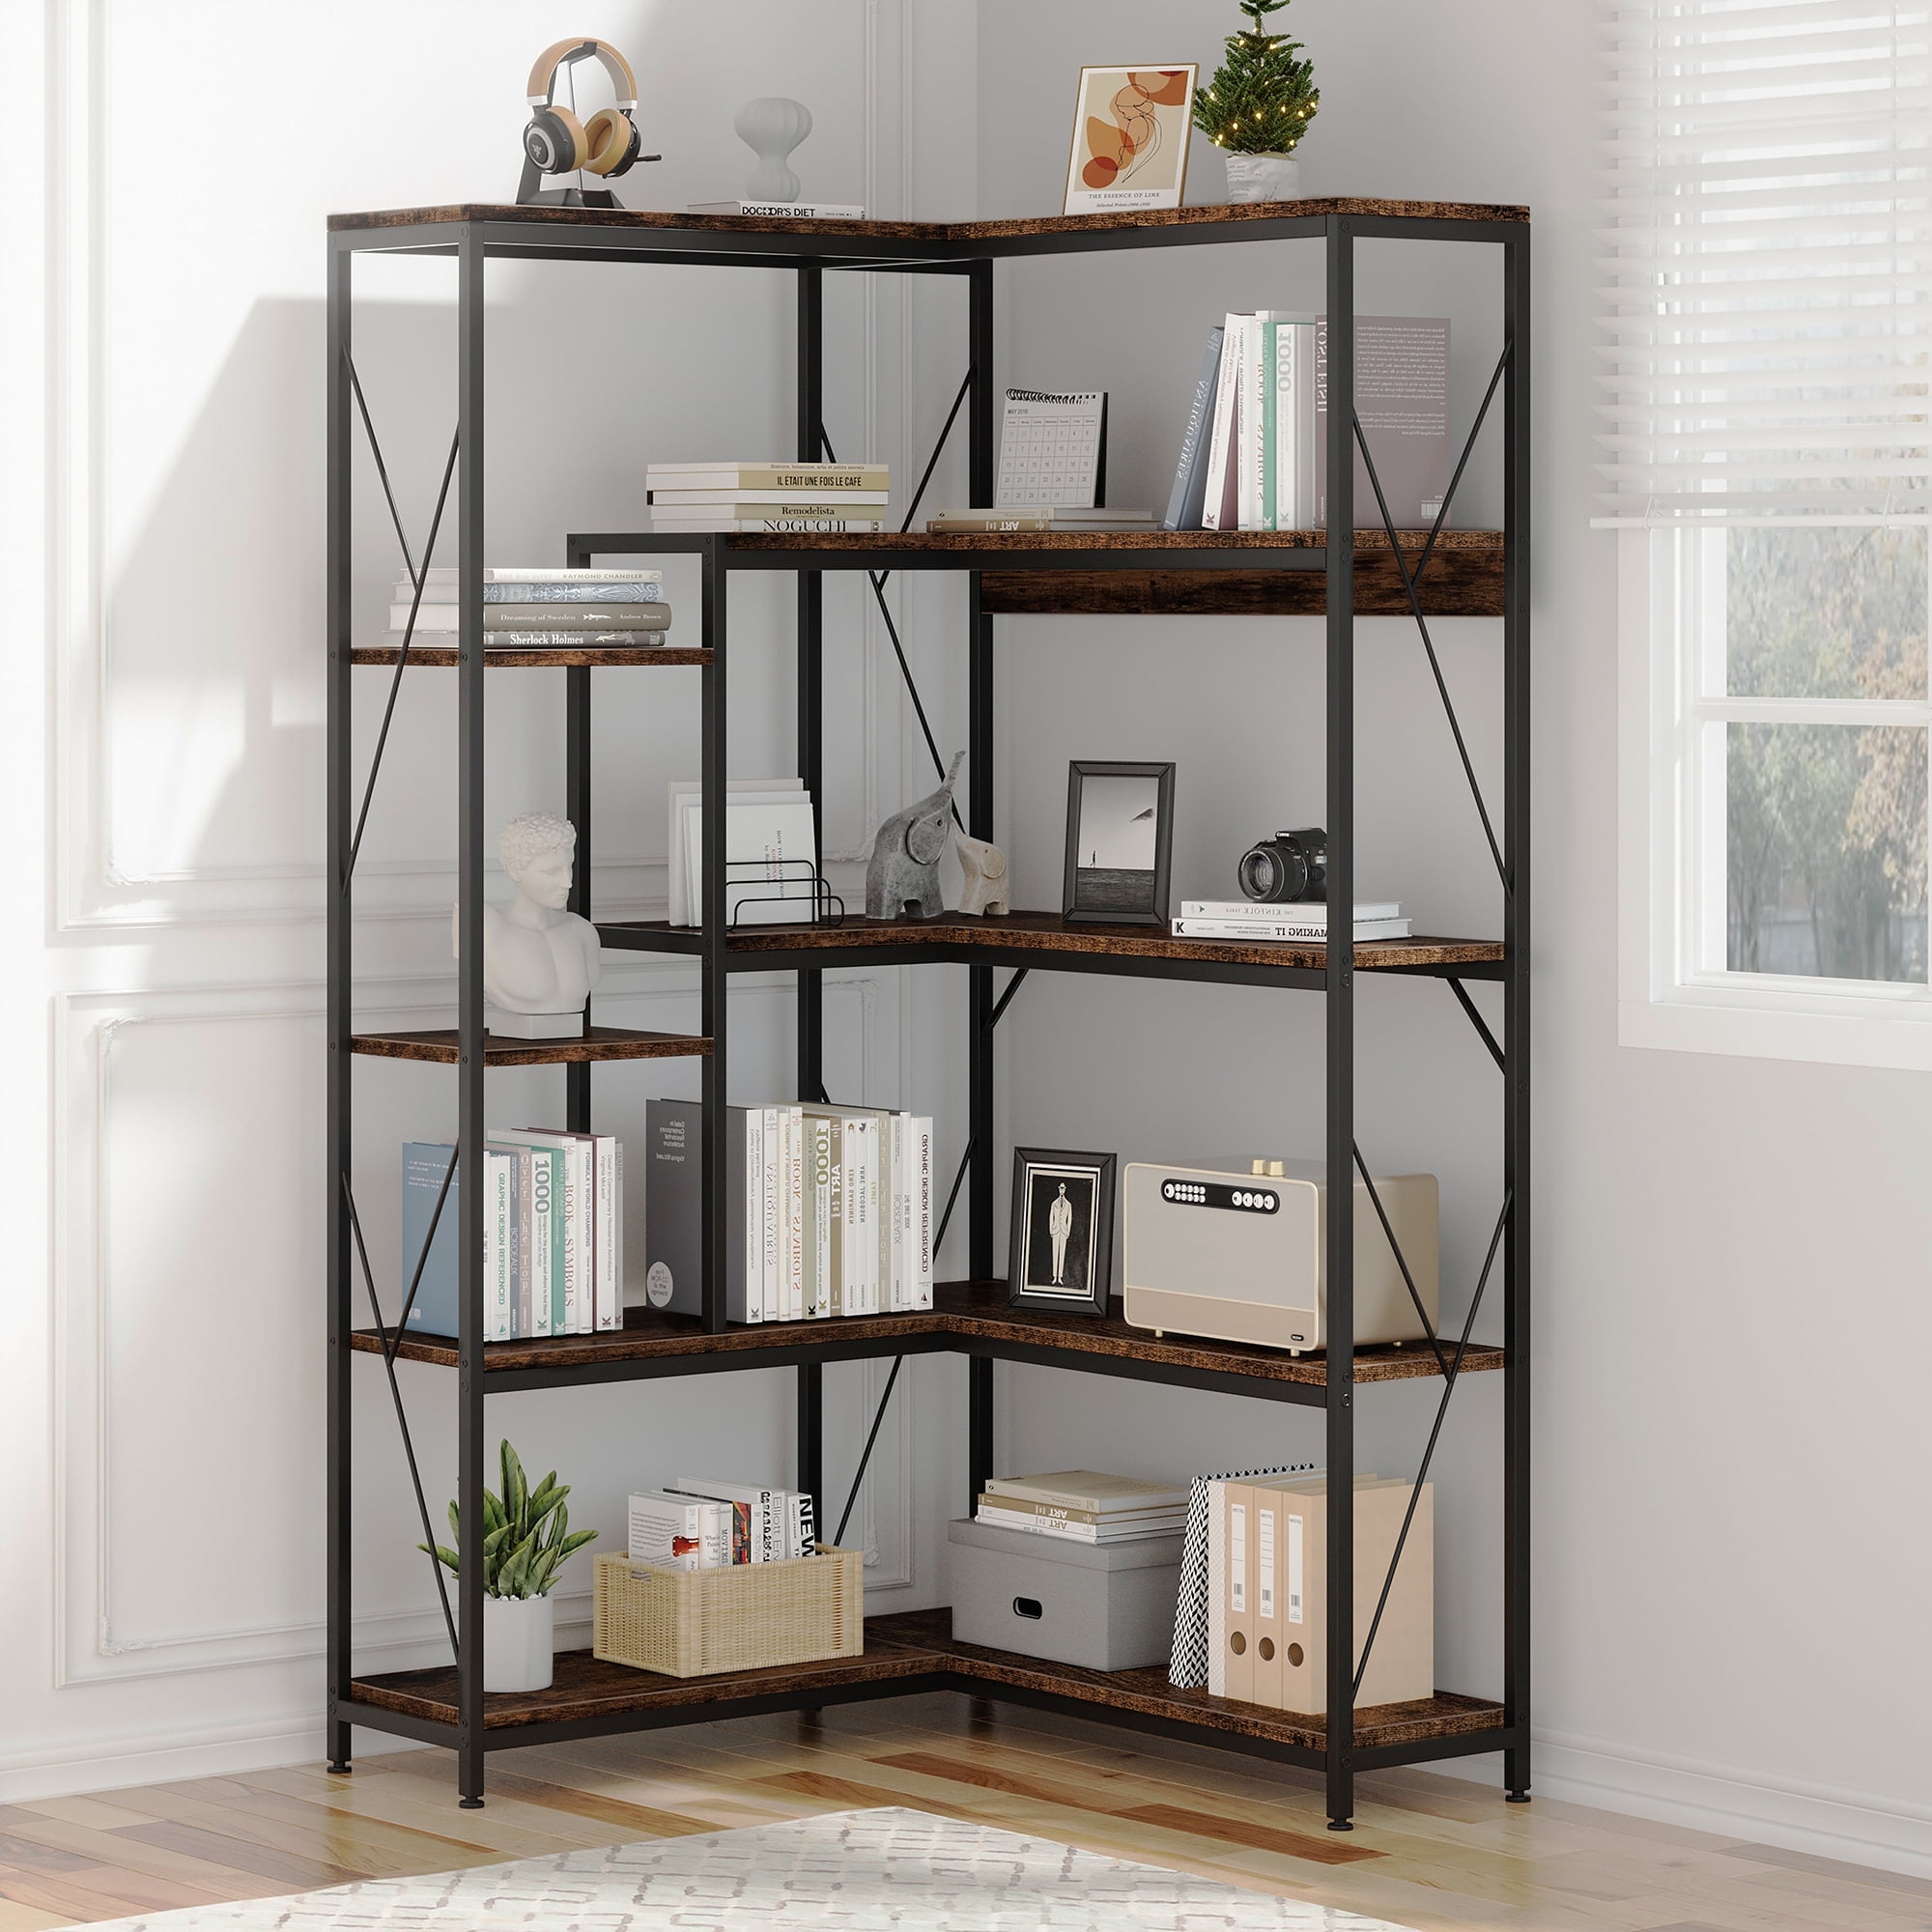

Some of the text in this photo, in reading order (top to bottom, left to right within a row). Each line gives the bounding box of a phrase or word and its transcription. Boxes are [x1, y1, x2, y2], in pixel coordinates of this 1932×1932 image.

[793, 208, 815, 217] DIET
[777, 476, 783, 486] IL
[805, 476, 818, 486] UNE
[819, 476, 834, 486] FOIS
[835, 476, 843, 486] LE
[844, 474, 862, 486] CAFÉ
[781, 506, 835, 515] Remodelista
[763, 520, 846, 531] NOGUCHI
[999, 522, 1019, 531] ART
[510, 634, 583, 644] Sherlock Holmes
[1176, 922, 1184, 933] K
[535, 1159, 551, 1214] 1000
[564, 1184, 574, 1306] BOOK SYMBOLS
[510, 1227, 519, 1275] BORDEAUX
[808, 1305, 816, 1315] K
[773, 1497, 781, 1535] Elliott
[1048, 1509, 1068, 1520] ART
[799, 1497, 815, 1557] NEW
[1048, 1520, 1067, 1530] ART
